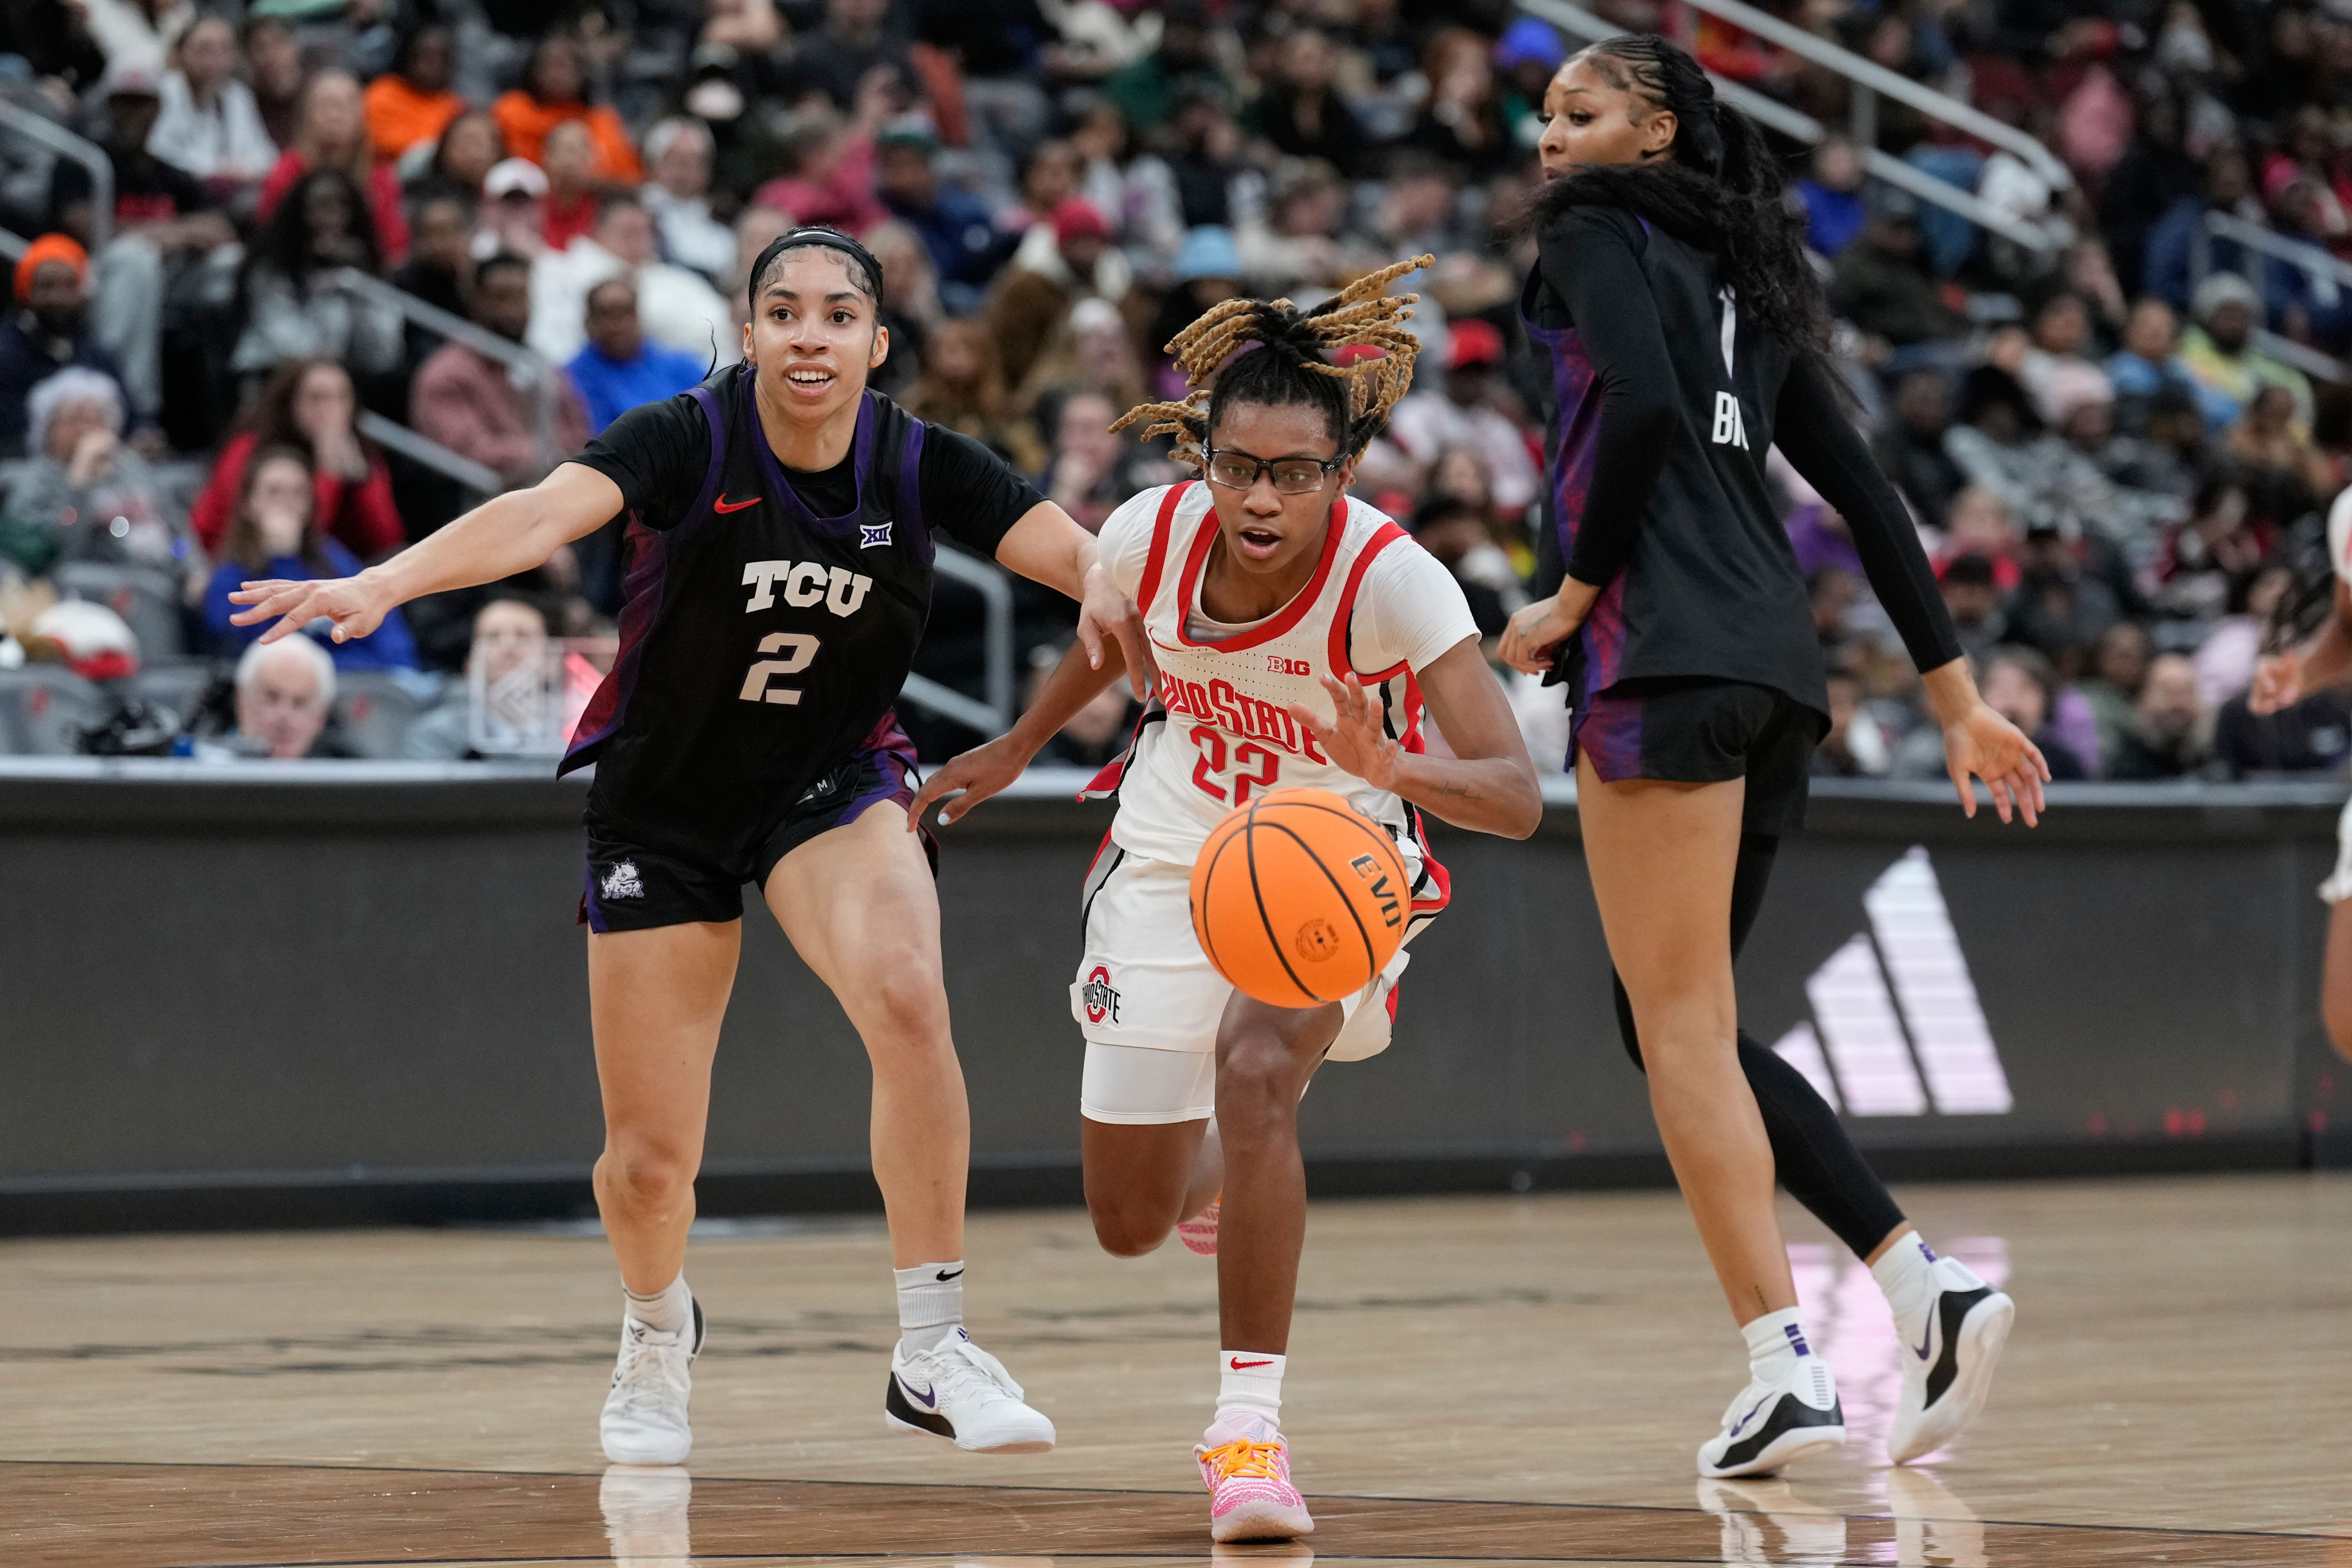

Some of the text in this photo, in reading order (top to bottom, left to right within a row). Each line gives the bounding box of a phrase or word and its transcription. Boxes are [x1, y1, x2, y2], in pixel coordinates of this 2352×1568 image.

[1712, 391, 1749, 451] BI
[742, 560, 872, 618] TCU
[739, 632, 821, 706] 2
[816, 779, 828, 792] M
[1189, 724, 1281, 809] 22
[1093, 980, 1121, 1024] STATE
